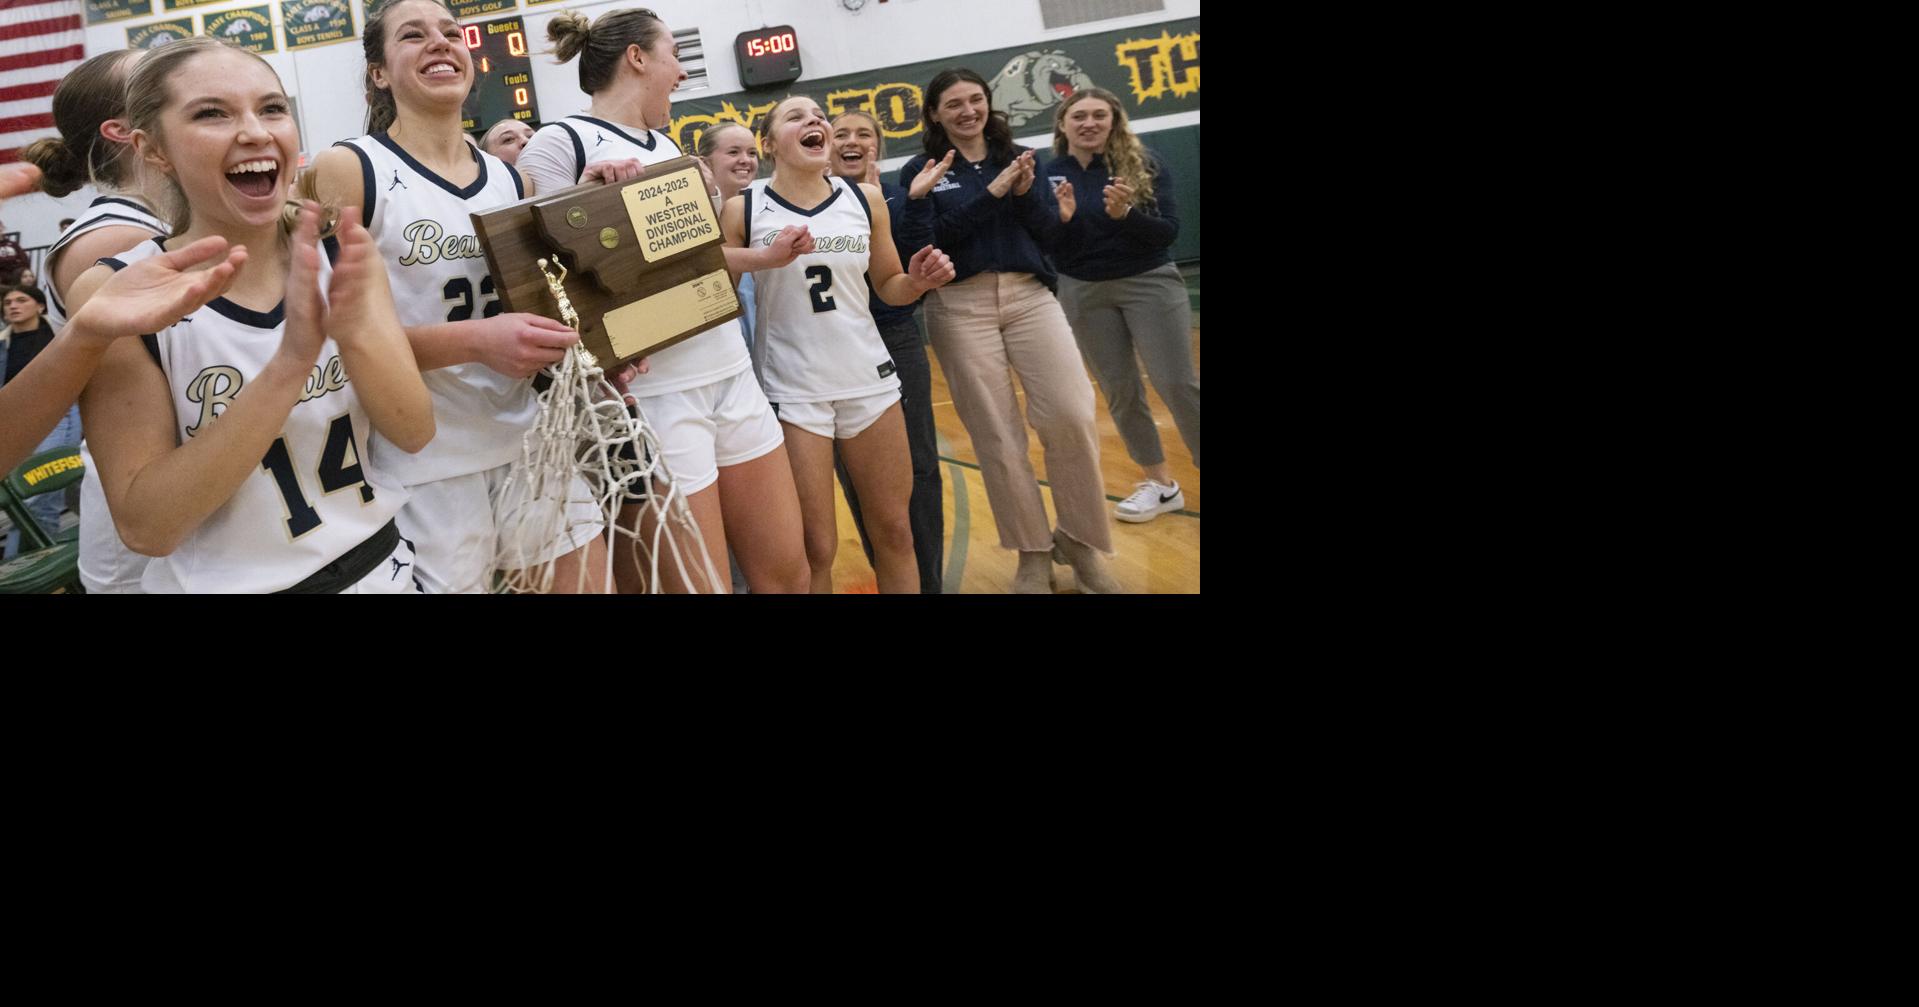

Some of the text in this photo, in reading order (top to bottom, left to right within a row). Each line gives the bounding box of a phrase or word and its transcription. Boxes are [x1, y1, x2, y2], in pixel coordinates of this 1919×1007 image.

[482, 2, 503, 11] GOLF
[487, 21, 519, 35] Guests
[507, 32, 525, 57] 0
[747, 33, 794, 56] 15:00
[481, 56, 489, 73] 1
[514, 87, 529, 106] 0
[513, 109, 532, 120] won
[638, 177, 689, 201] 2024-2025
[665, 196, 673, 206] A
[645, 200, 699, 226] WESTERN
[646, 212, 706, 240] DIVISIONAL
[649, 223, 712, 252] CHAMPIONS
[803, 264, 838, 315] 2
[260, 410, 376, 543] 14
